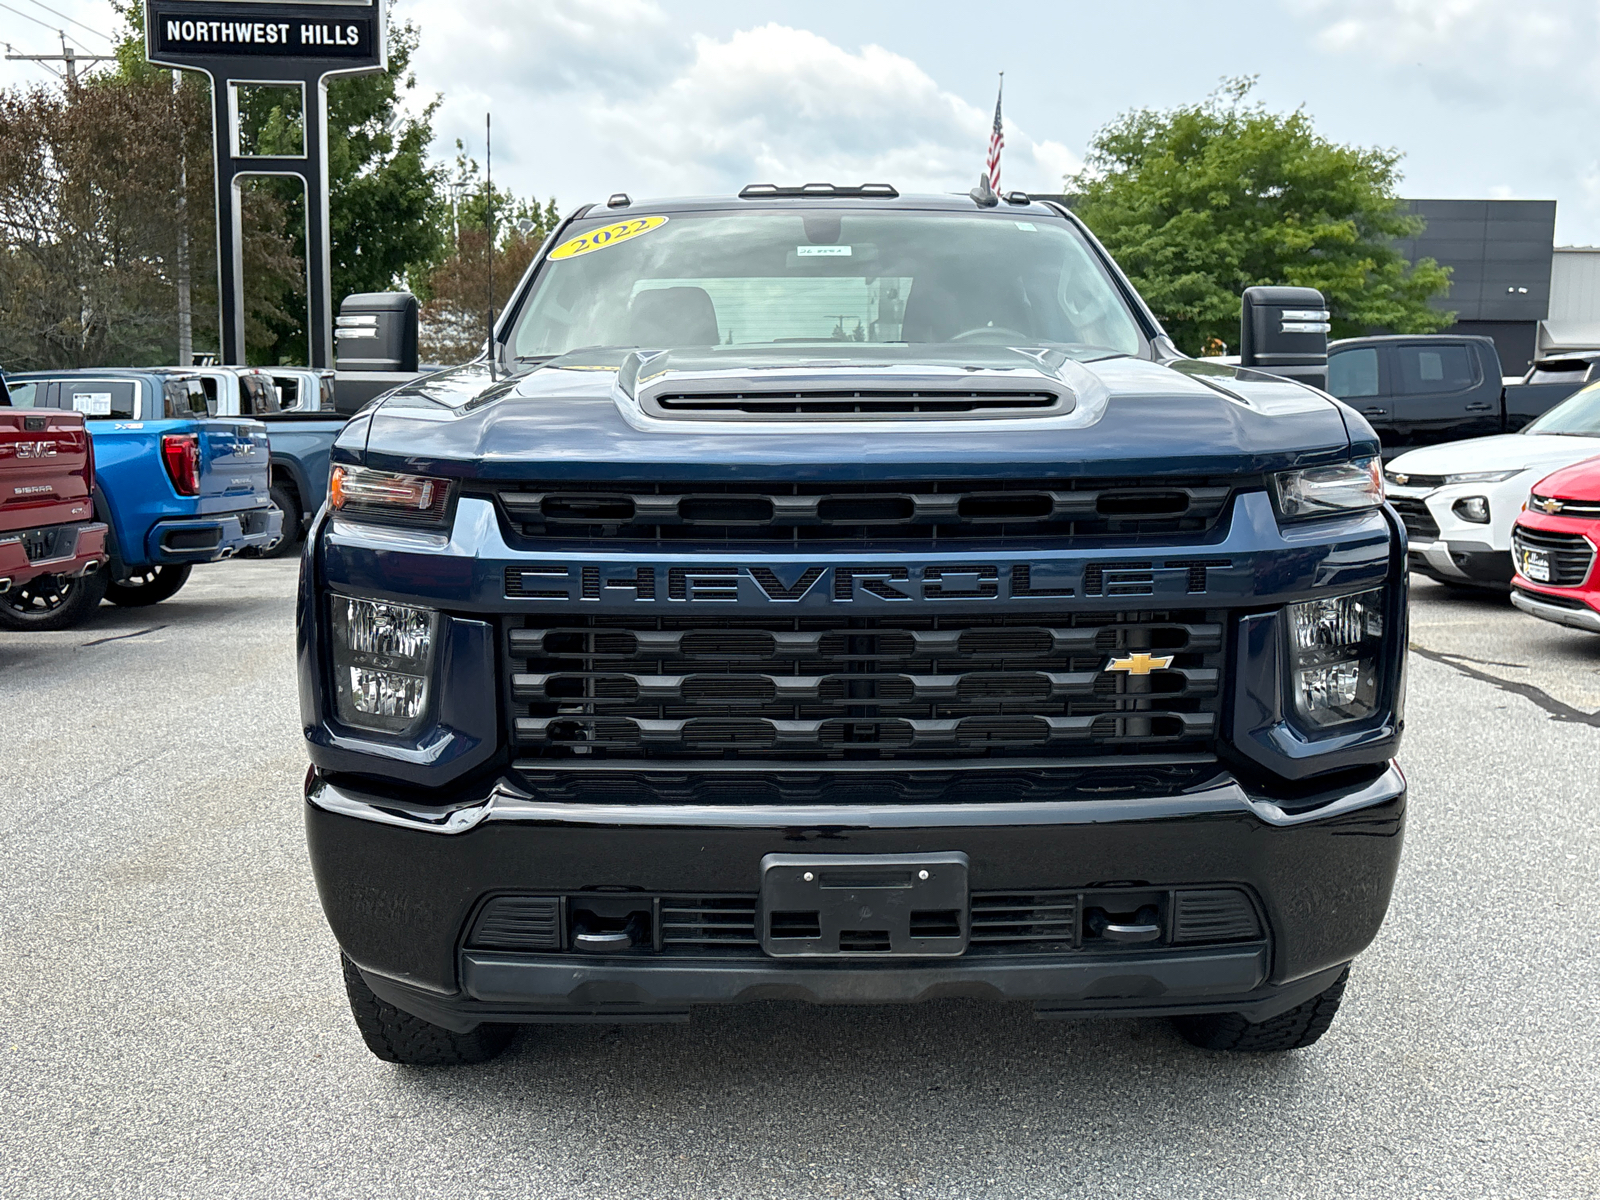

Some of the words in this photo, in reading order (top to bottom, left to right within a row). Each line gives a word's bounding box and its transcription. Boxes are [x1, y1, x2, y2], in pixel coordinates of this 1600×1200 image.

[166, 20, 290, 44] NORTHWEST
[300, 25, 360, 46] HILLS
[570, 220, 651, 254] 2022
[15, 441, 57, 458] GMC
[14, 485, 53, 494] SIERRA
[504, 558, 1234, 602] CHEVROLET
